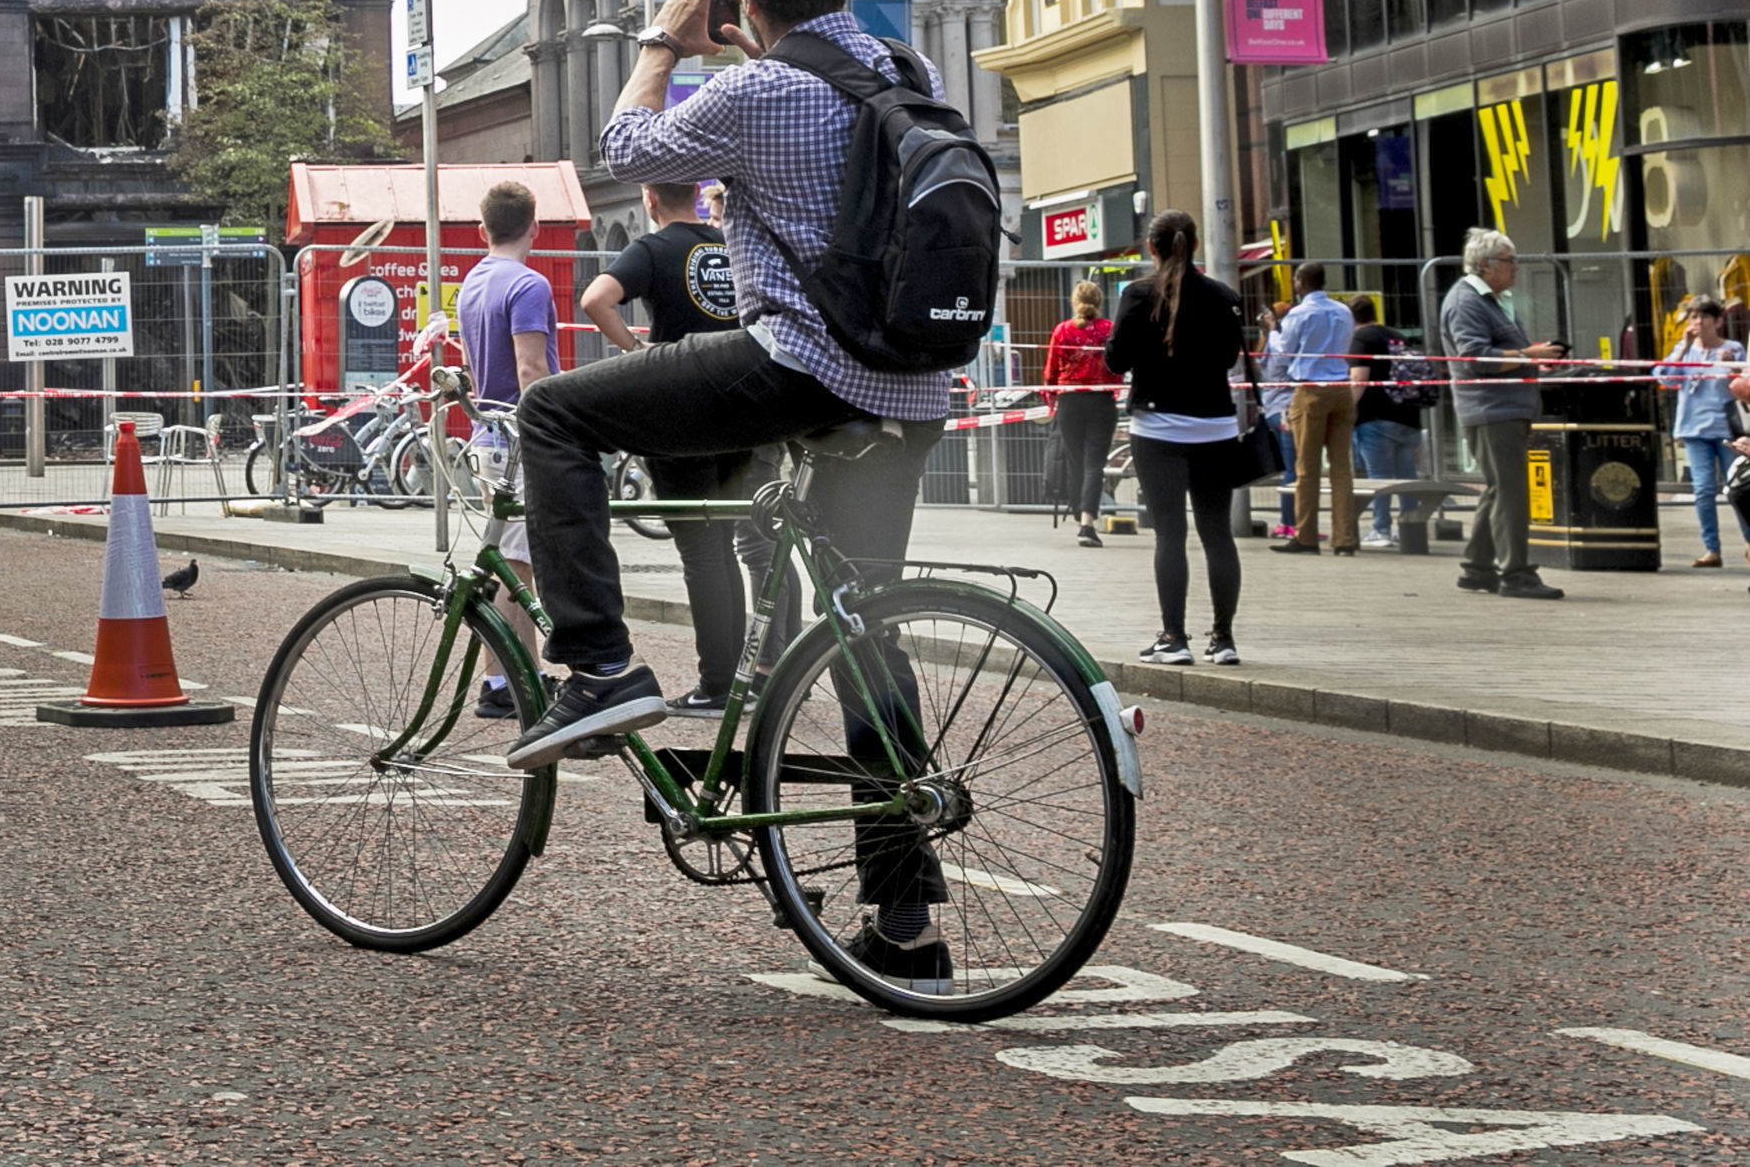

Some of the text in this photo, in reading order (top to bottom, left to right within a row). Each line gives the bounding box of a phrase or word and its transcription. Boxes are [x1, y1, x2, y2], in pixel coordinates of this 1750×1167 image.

[1054, 214, 1087, 241] SPAR
[370, 262, 415, 277] coffee
[14, 278, 122, 298] WARNING
[363, 308, 387, 317] bikes
[17, 309, 119, 332] NOONAN
[23, 336, 119, 347] Tel: 028 9077 4799
[1587, 434, 1641, 448] LITTER
